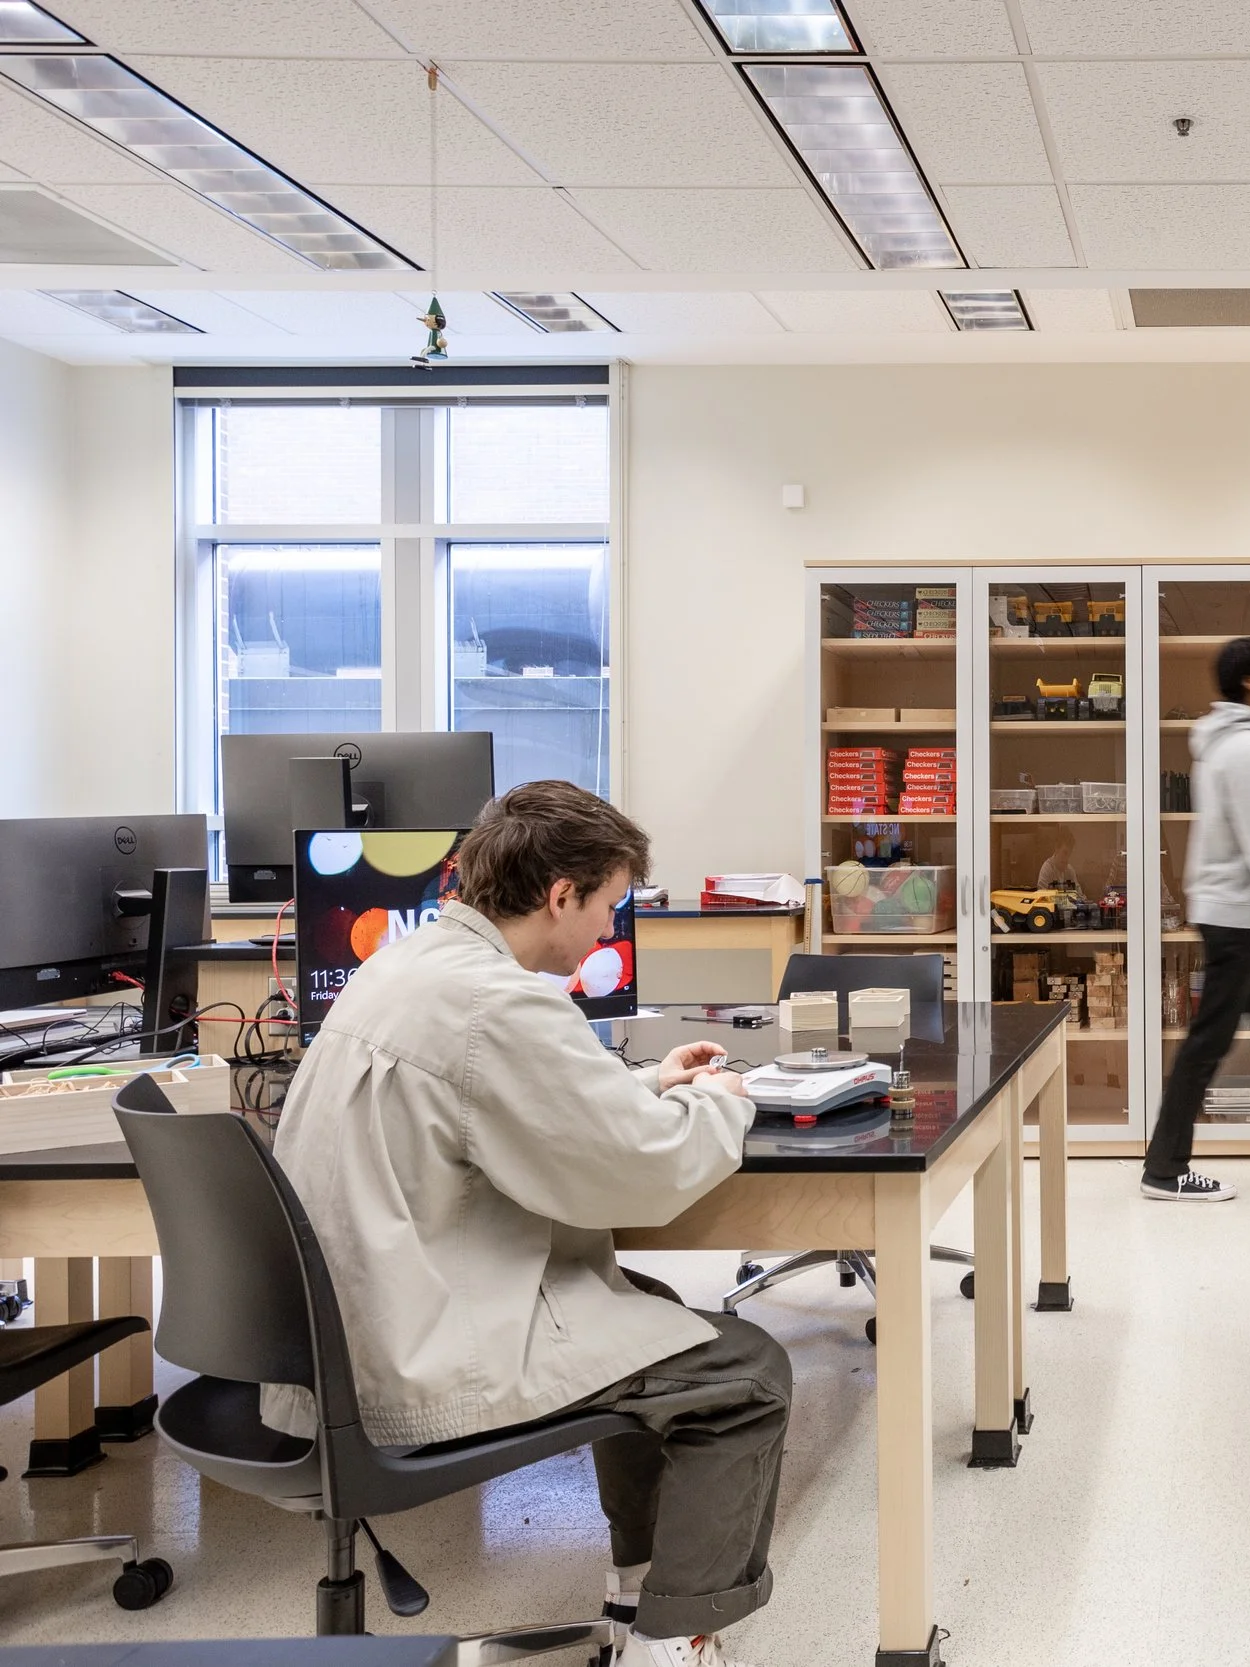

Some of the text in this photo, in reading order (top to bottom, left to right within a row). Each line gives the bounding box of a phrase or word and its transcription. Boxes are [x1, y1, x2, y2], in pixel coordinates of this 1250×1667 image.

[866, 600, 900, 608] CHECKERS
[866, 610, 900, 618] CHECKERS
[866, 620, 900, 628] CHECKERS
[311, 990, 339, 1000] Friday
